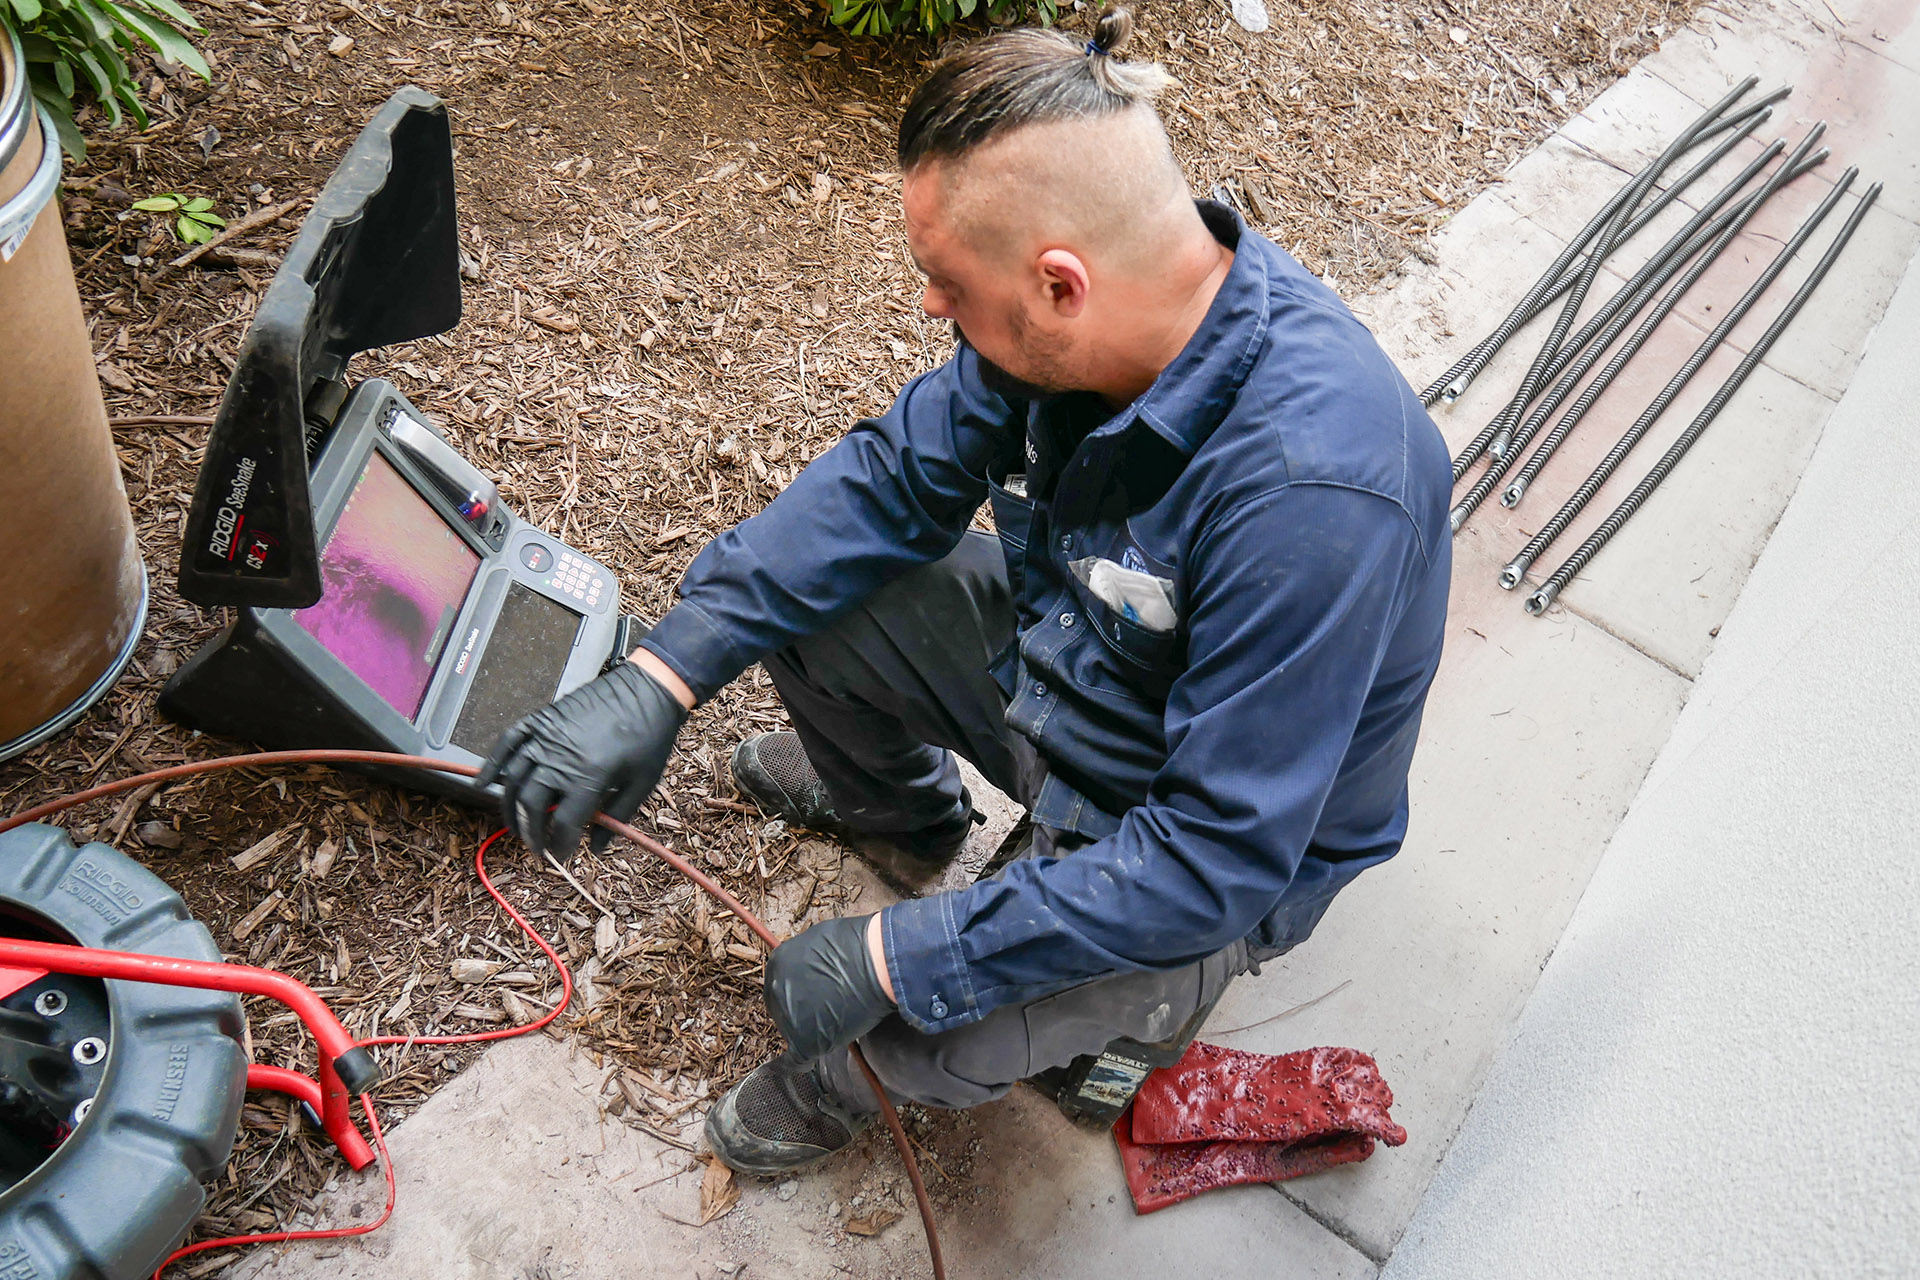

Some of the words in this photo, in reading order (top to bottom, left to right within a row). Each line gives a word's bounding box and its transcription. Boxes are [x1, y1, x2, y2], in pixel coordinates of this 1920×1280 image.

[209, 506, 237, 558] RIDGID
[225, 457, 257, 509] SeeSnake
[58, 877, 122, 926] Kollmann
[75, 858, 144, 911] RIDGID
[151, 1043, 189, 1122] SEESNAKE
